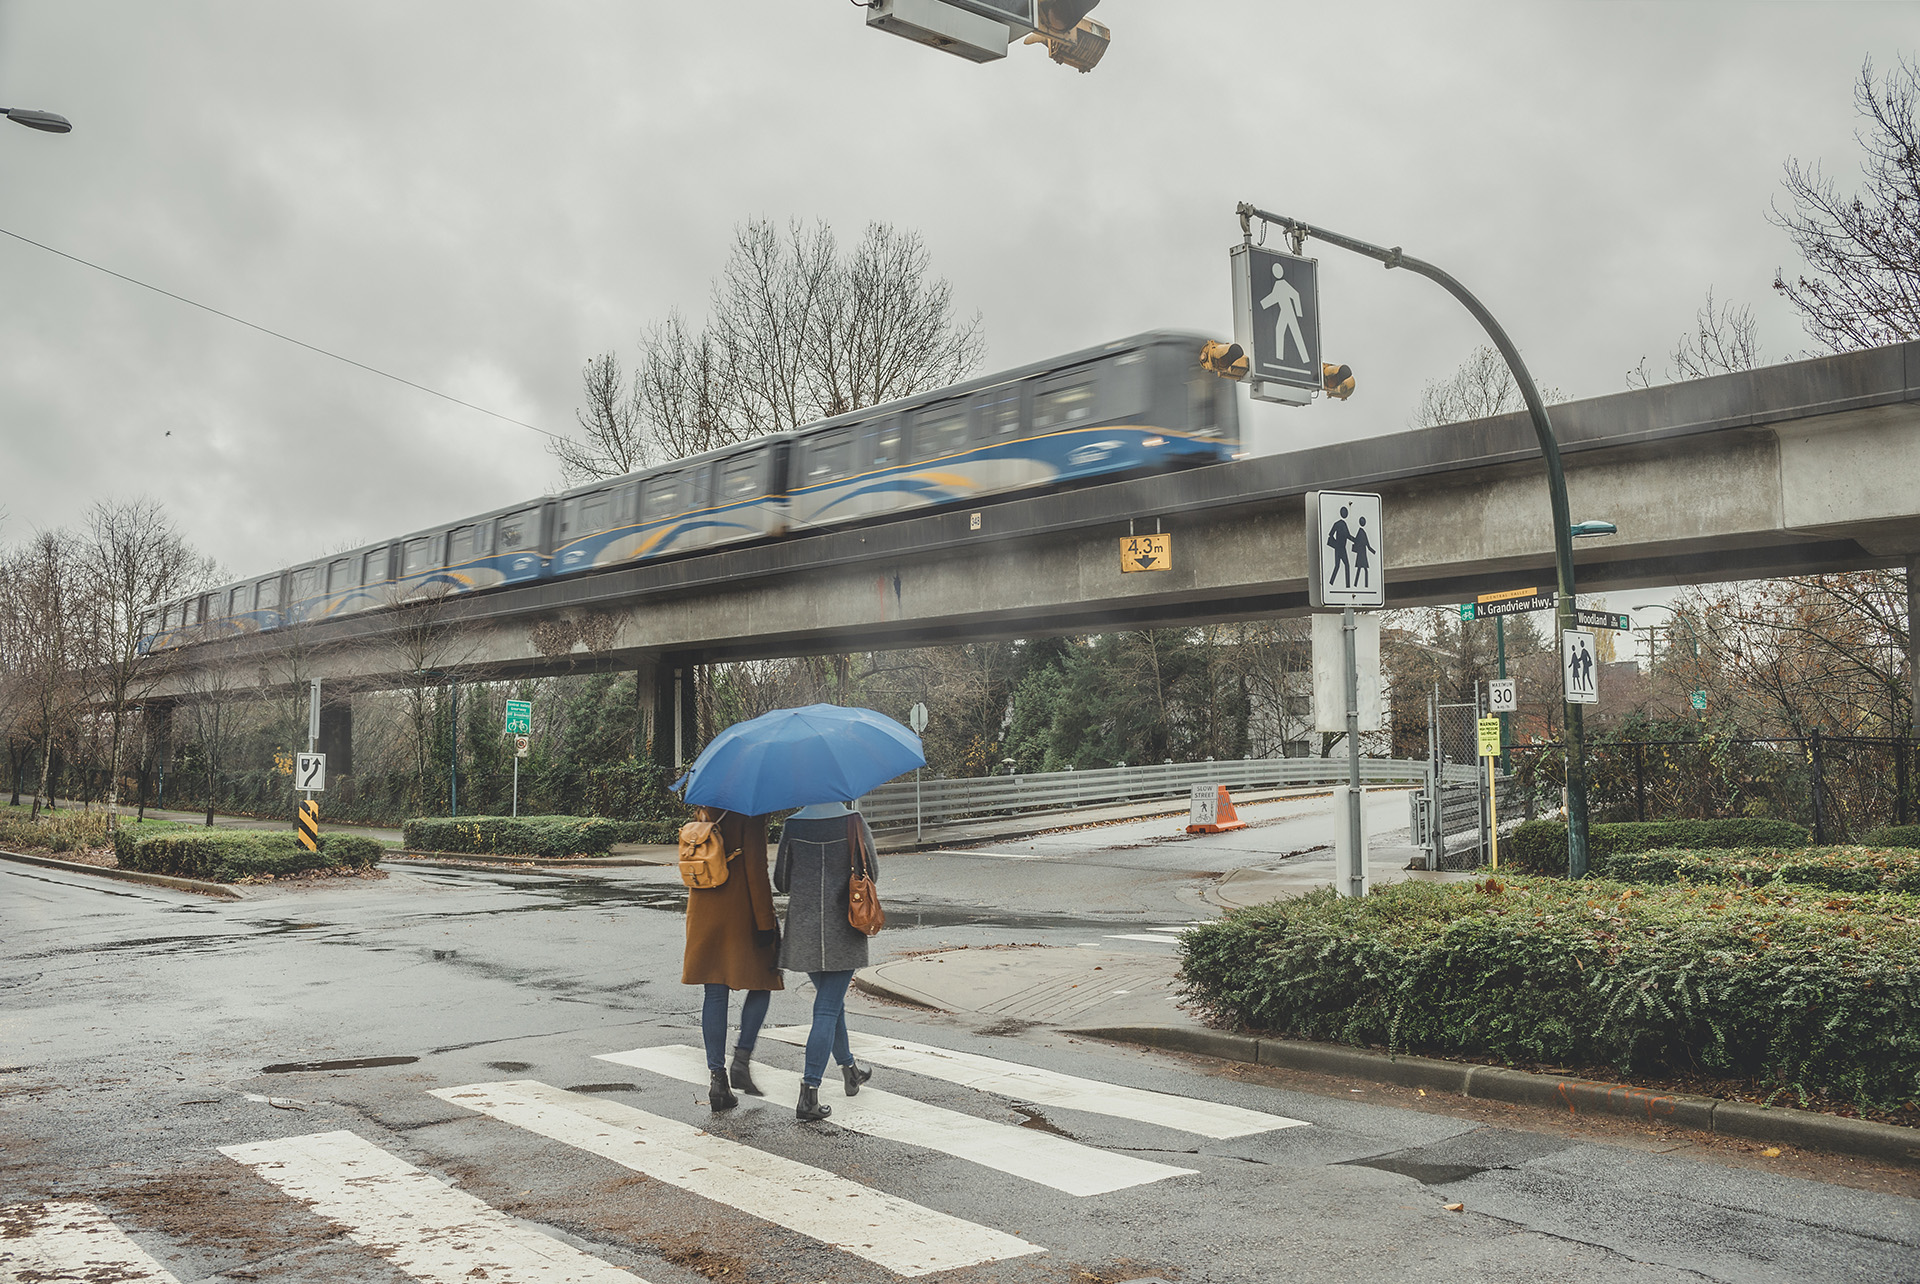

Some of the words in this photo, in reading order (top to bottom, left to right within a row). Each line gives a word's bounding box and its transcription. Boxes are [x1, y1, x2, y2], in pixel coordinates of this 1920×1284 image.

[1477, 605, 1486, 616] N.
[1488, 601, 1530, 615] Grandview
[1532, 597, 1552, 609] Hwy.
[1577, 612, 1607, 626] Woodland
[1493, 688, 1512, 703] 30
